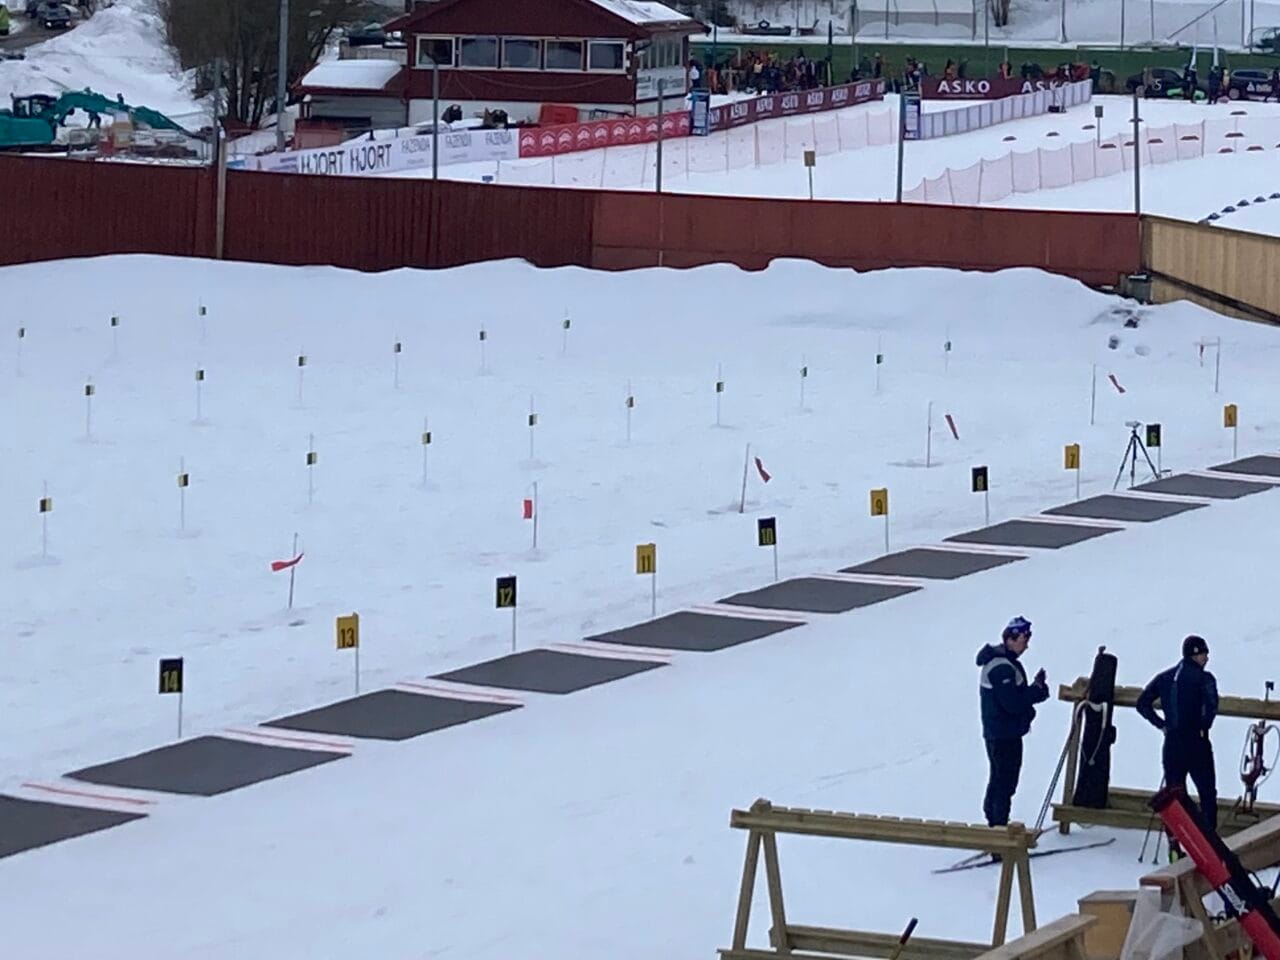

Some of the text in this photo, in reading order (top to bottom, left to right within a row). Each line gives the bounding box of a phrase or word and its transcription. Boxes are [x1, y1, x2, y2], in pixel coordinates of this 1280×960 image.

[937, 80, 990, 94] ASKO
[301, 150, 345, 175] HJORT
[350, 143, 392, 172] HJORT
[1069, 453, 1076, 468] 7
[976, 475, 984, 490] 8
[875, 498, 883, 513] 9
[760, 527, 773, 544] 10
[640, 554, 651, 573] 11
[499, 587, 513, 606] 12
[340, 627, 355, 648] 13
[162, 670, 179, 692] 14
